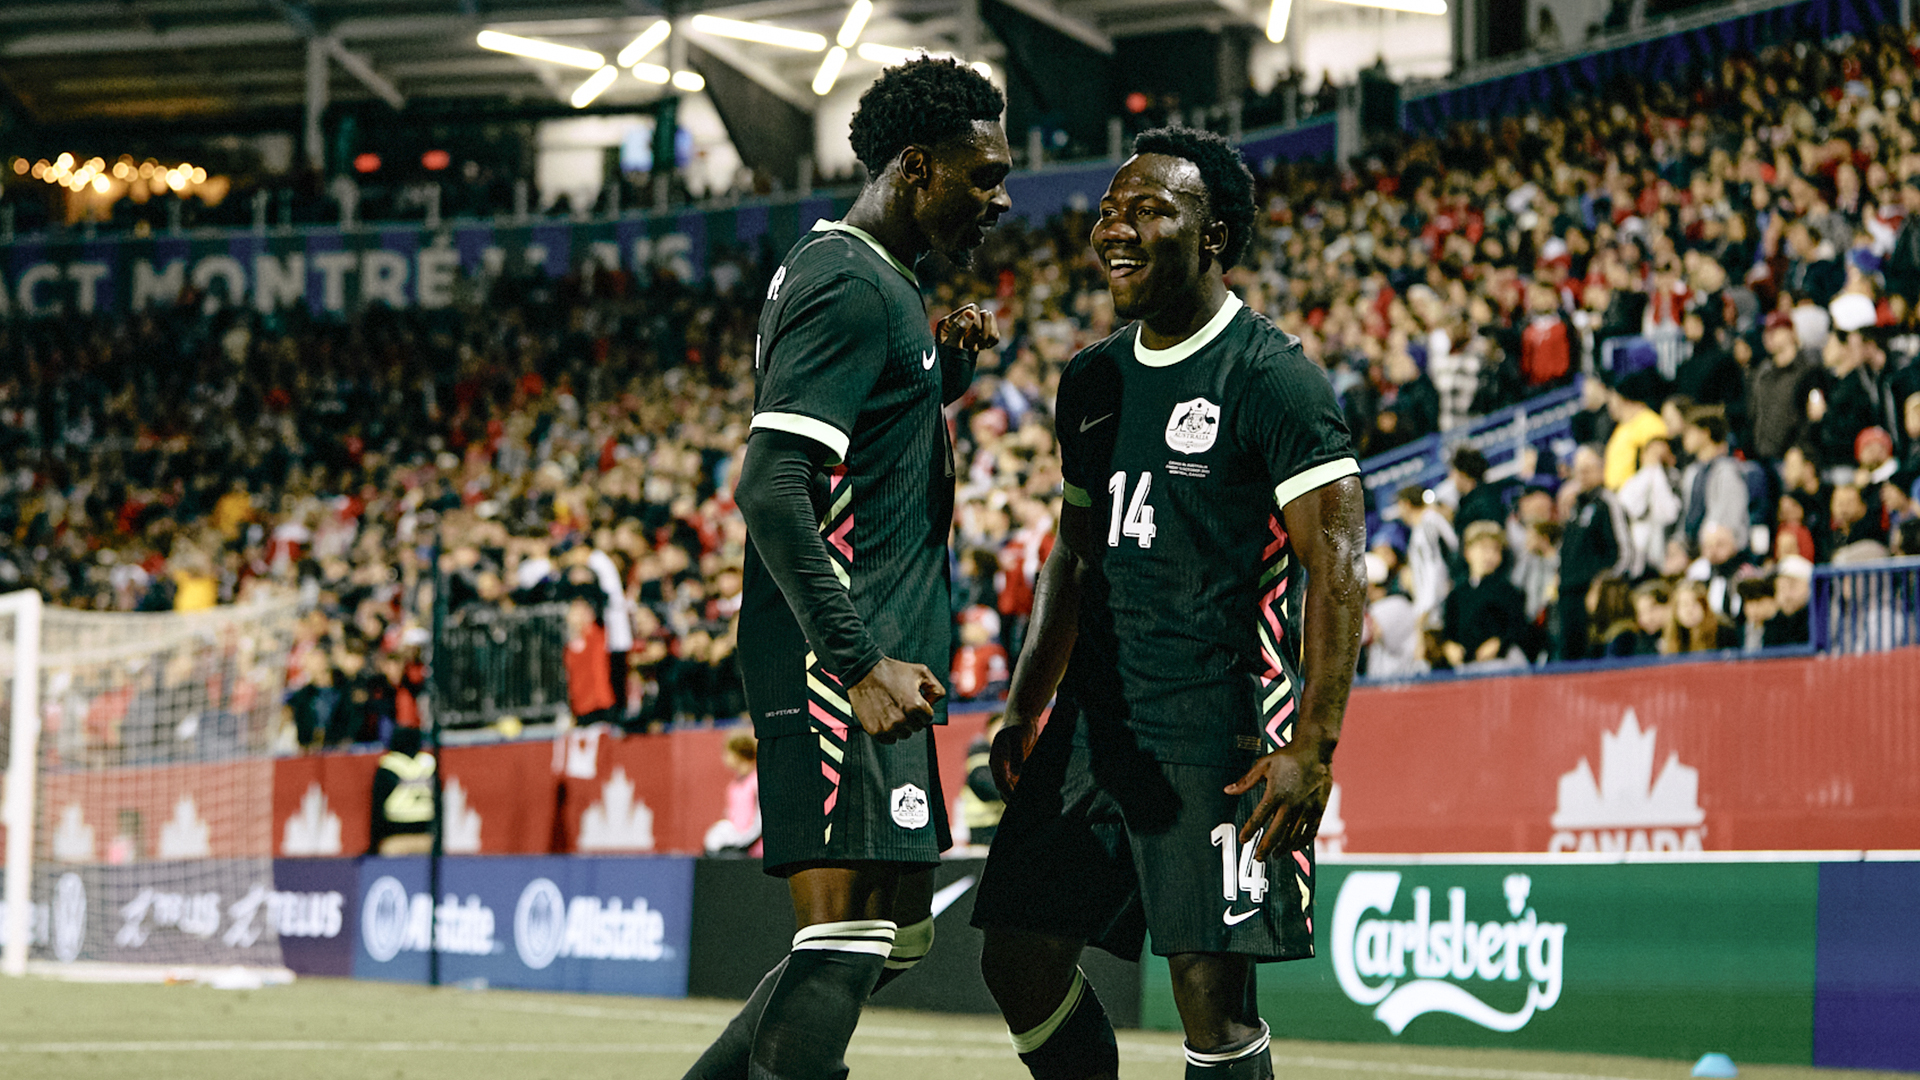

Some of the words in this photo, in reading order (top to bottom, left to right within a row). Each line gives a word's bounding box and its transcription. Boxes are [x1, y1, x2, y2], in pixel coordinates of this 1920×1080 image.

[0, 260, 108, 315] CT
[1107, 470, 1157, 549] 14
[1210, 822, 1269, 904] 14
[266, 890, 344, 938] TELUS
[402, 891, 496, 956] Alstate
[558, 894, 665, 961] Allstate
[1331, 870, 1567, 1012] Carlsberg
